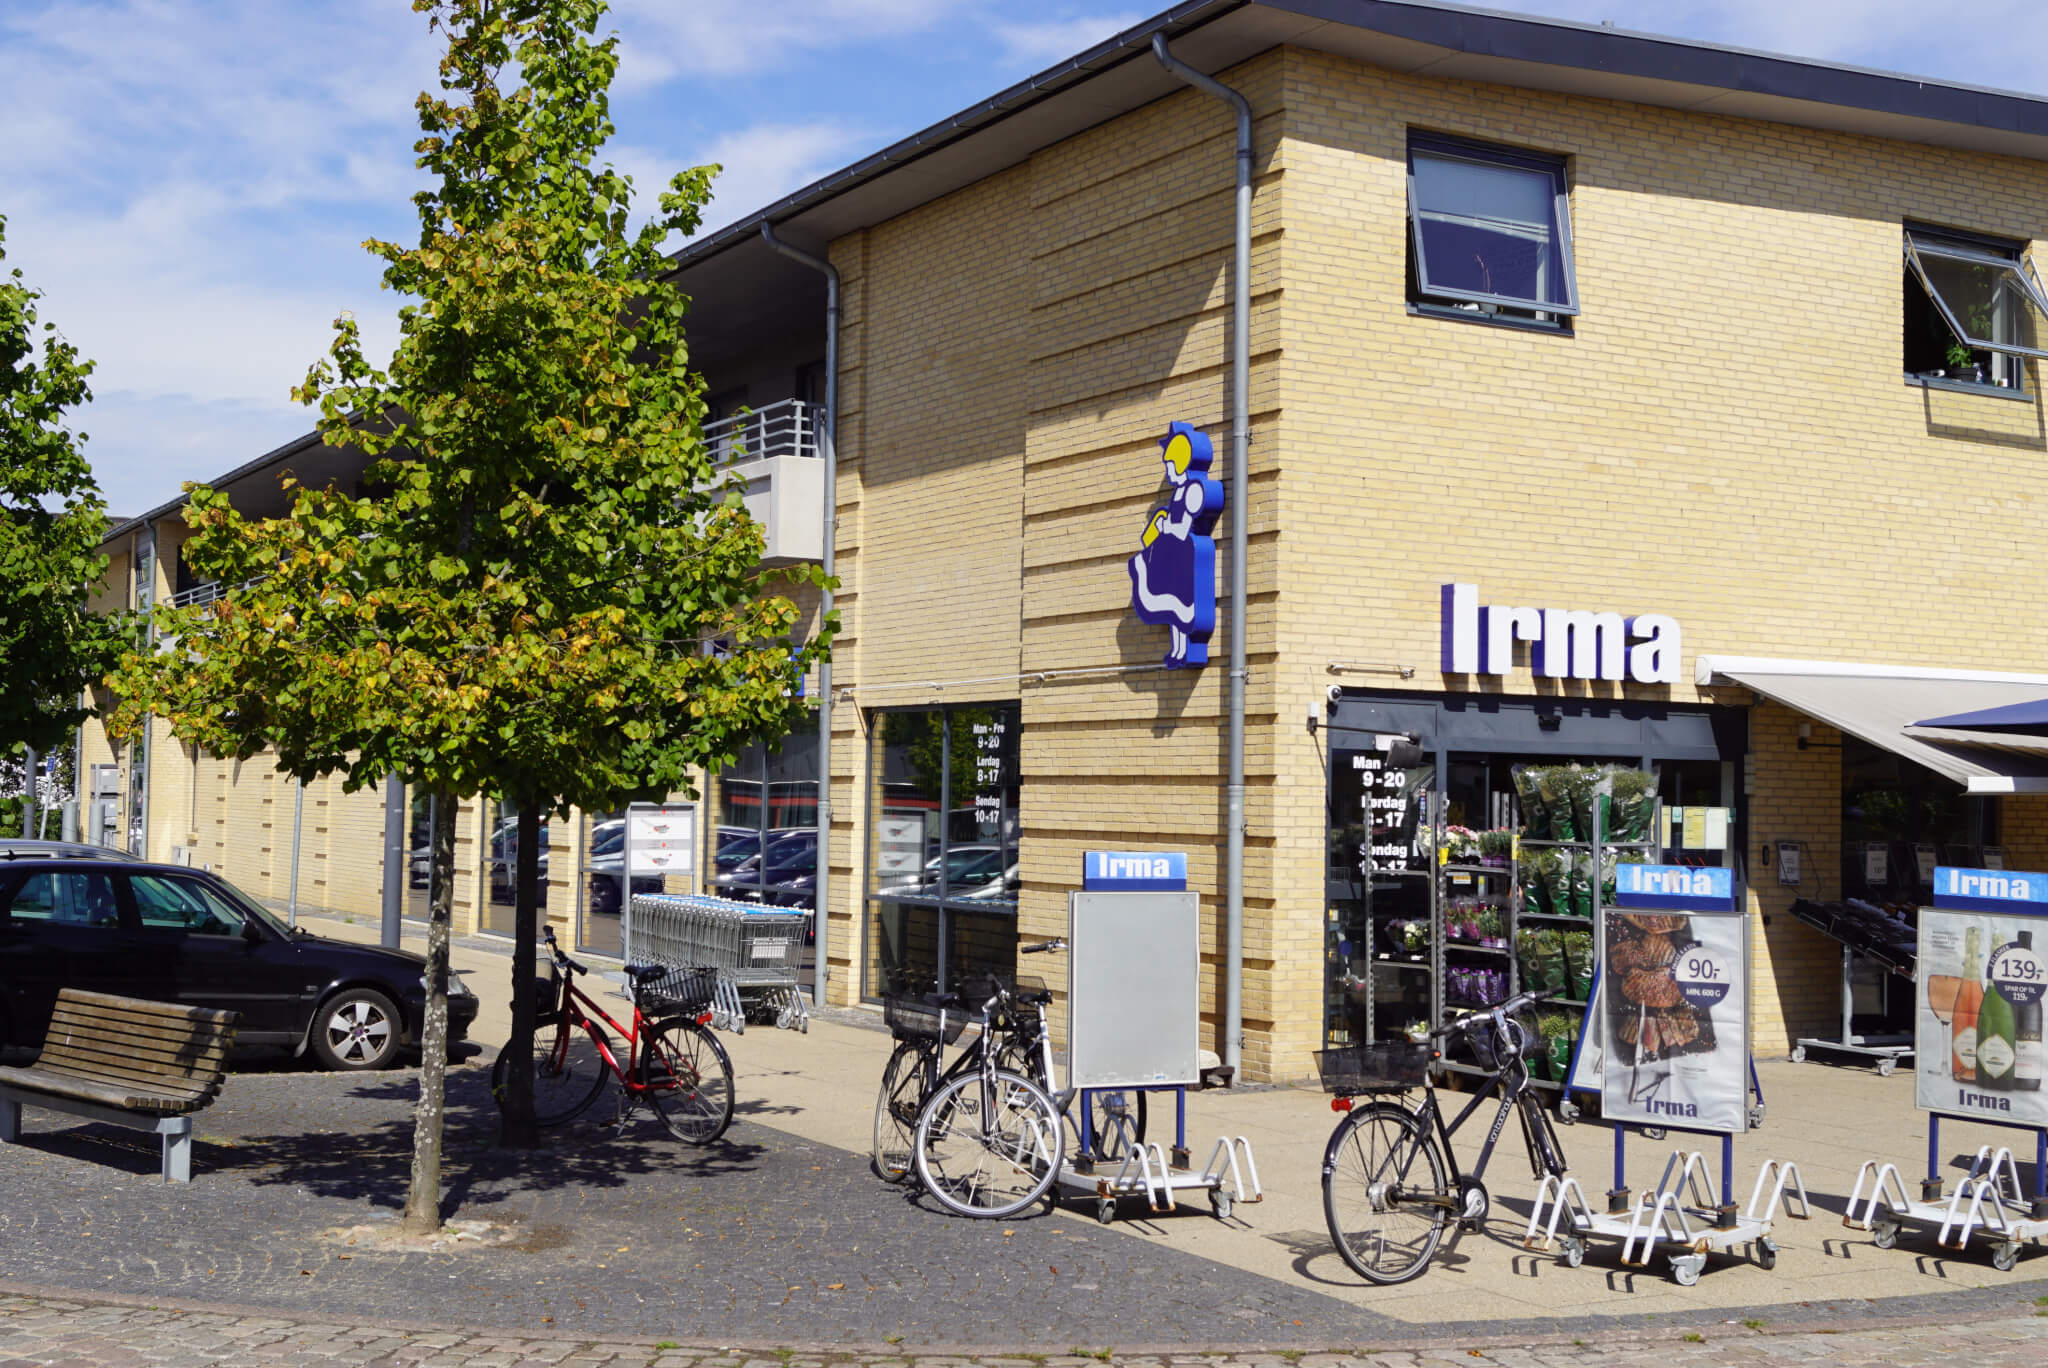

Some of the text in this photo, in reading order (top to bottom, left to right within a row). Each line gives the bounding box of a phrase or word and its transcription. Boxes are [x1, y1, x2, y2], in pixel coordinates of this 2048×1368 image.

[1443, 583, 1682, 684] Irma
[973, 723, 988, 734] Man
[993, 722, 1005, 734] Fre
[1353, 756, 1381, 769] Man
[1098, 853, 1170, 878] Irma
[1633, 866, 1712, 895] Irma
[1950, 869, 2030, 900] Irma
[1646, 1096, 1697, 1118] Irma
[1960, 1089, 2011, 1111] Irma
